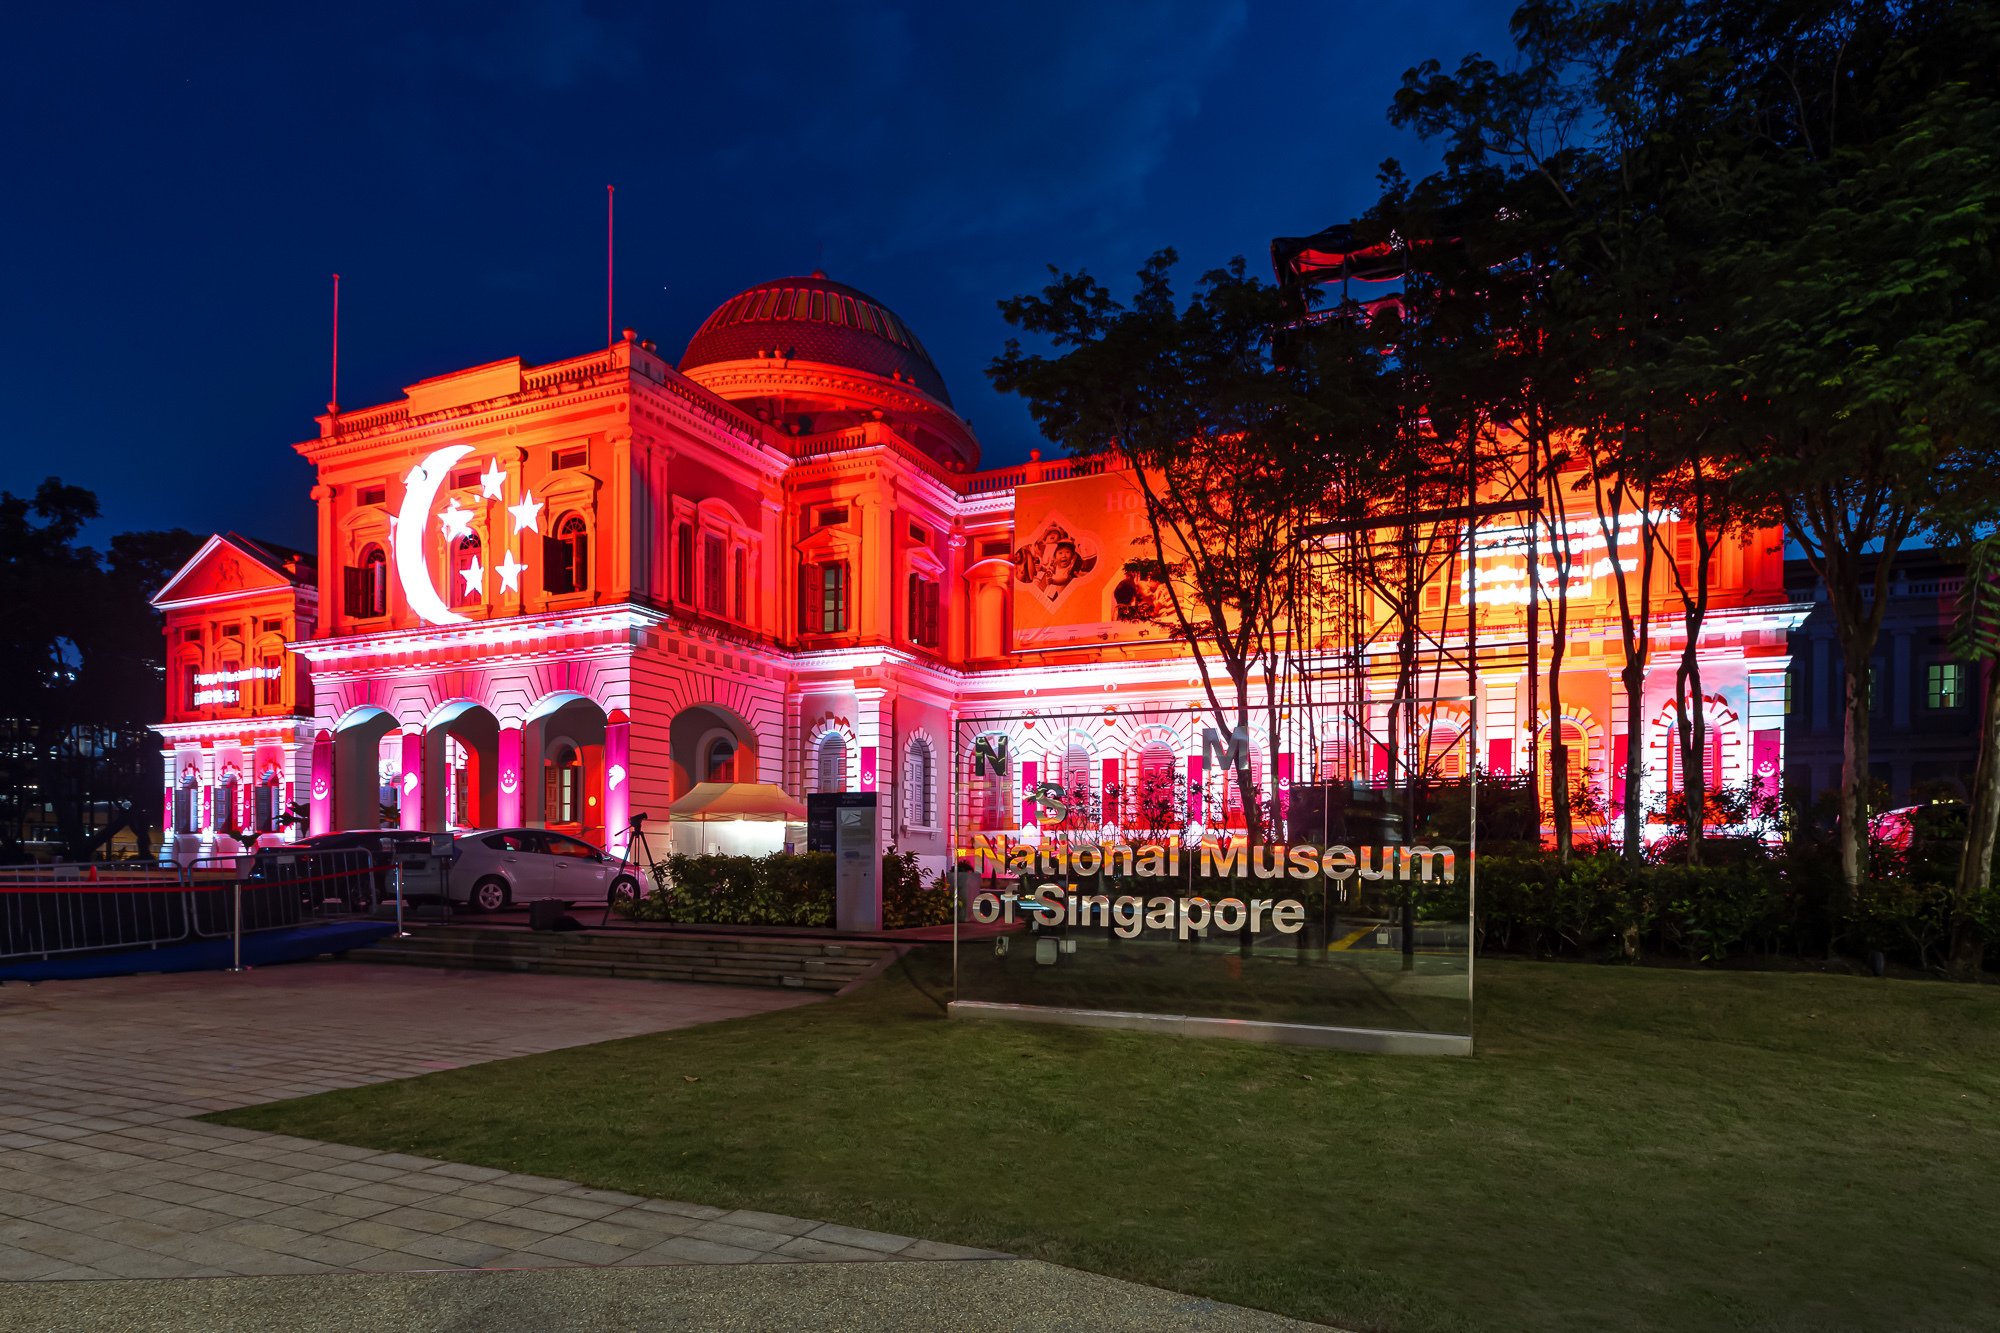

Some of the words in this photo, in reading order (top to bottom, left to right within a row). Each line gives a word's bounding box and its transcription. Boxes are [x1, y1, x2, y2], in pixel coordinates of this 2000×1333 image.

[975, 735, 1009, 776] N
[973, 833, 1180, 877] National
[1200, 834, 1456, 881] Museum
[972, 883, 1020, 924] of
[1032, 882, 1305, 941] Singapore
